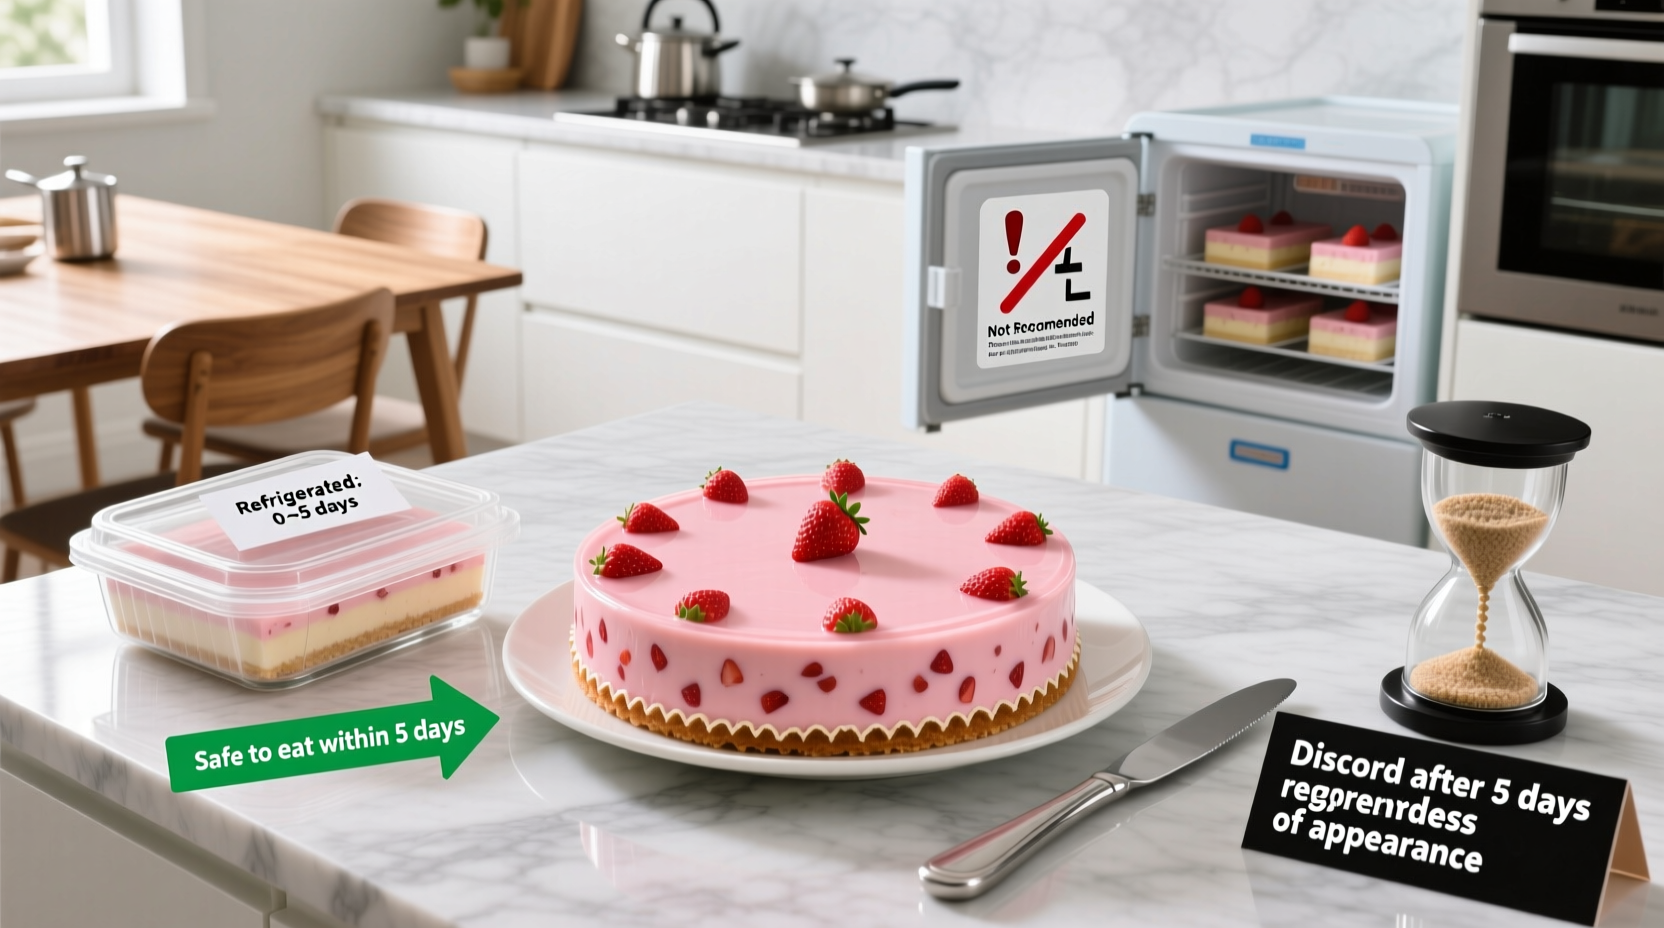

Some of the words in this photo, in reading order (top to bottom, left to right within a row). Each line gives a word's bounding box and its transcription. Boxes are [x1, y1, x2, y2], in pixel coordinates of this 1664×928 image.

[987, 324, 1011, 338] Not
[235, 473, 362, 515] Refrigerated:
[314, 496, 359, 516] days
[194, 745, 244, 771] Safe
[247, 744, 273, 764] to
[277, 736, 315, 760] eat
[318, 725, 390, 755] within
[395, 722, 409, 744] 5
[413, 718, 466, 744] days
[1290, 739, 1406, 785] Discord
[1409, 763, 1485, 800] after
[1490, 777, 1512, 805] 5
[1517, 782, 1592, 825] days
[1272, 807, 1307, 835] of
[1308, 819, 1483, 873] appearance
